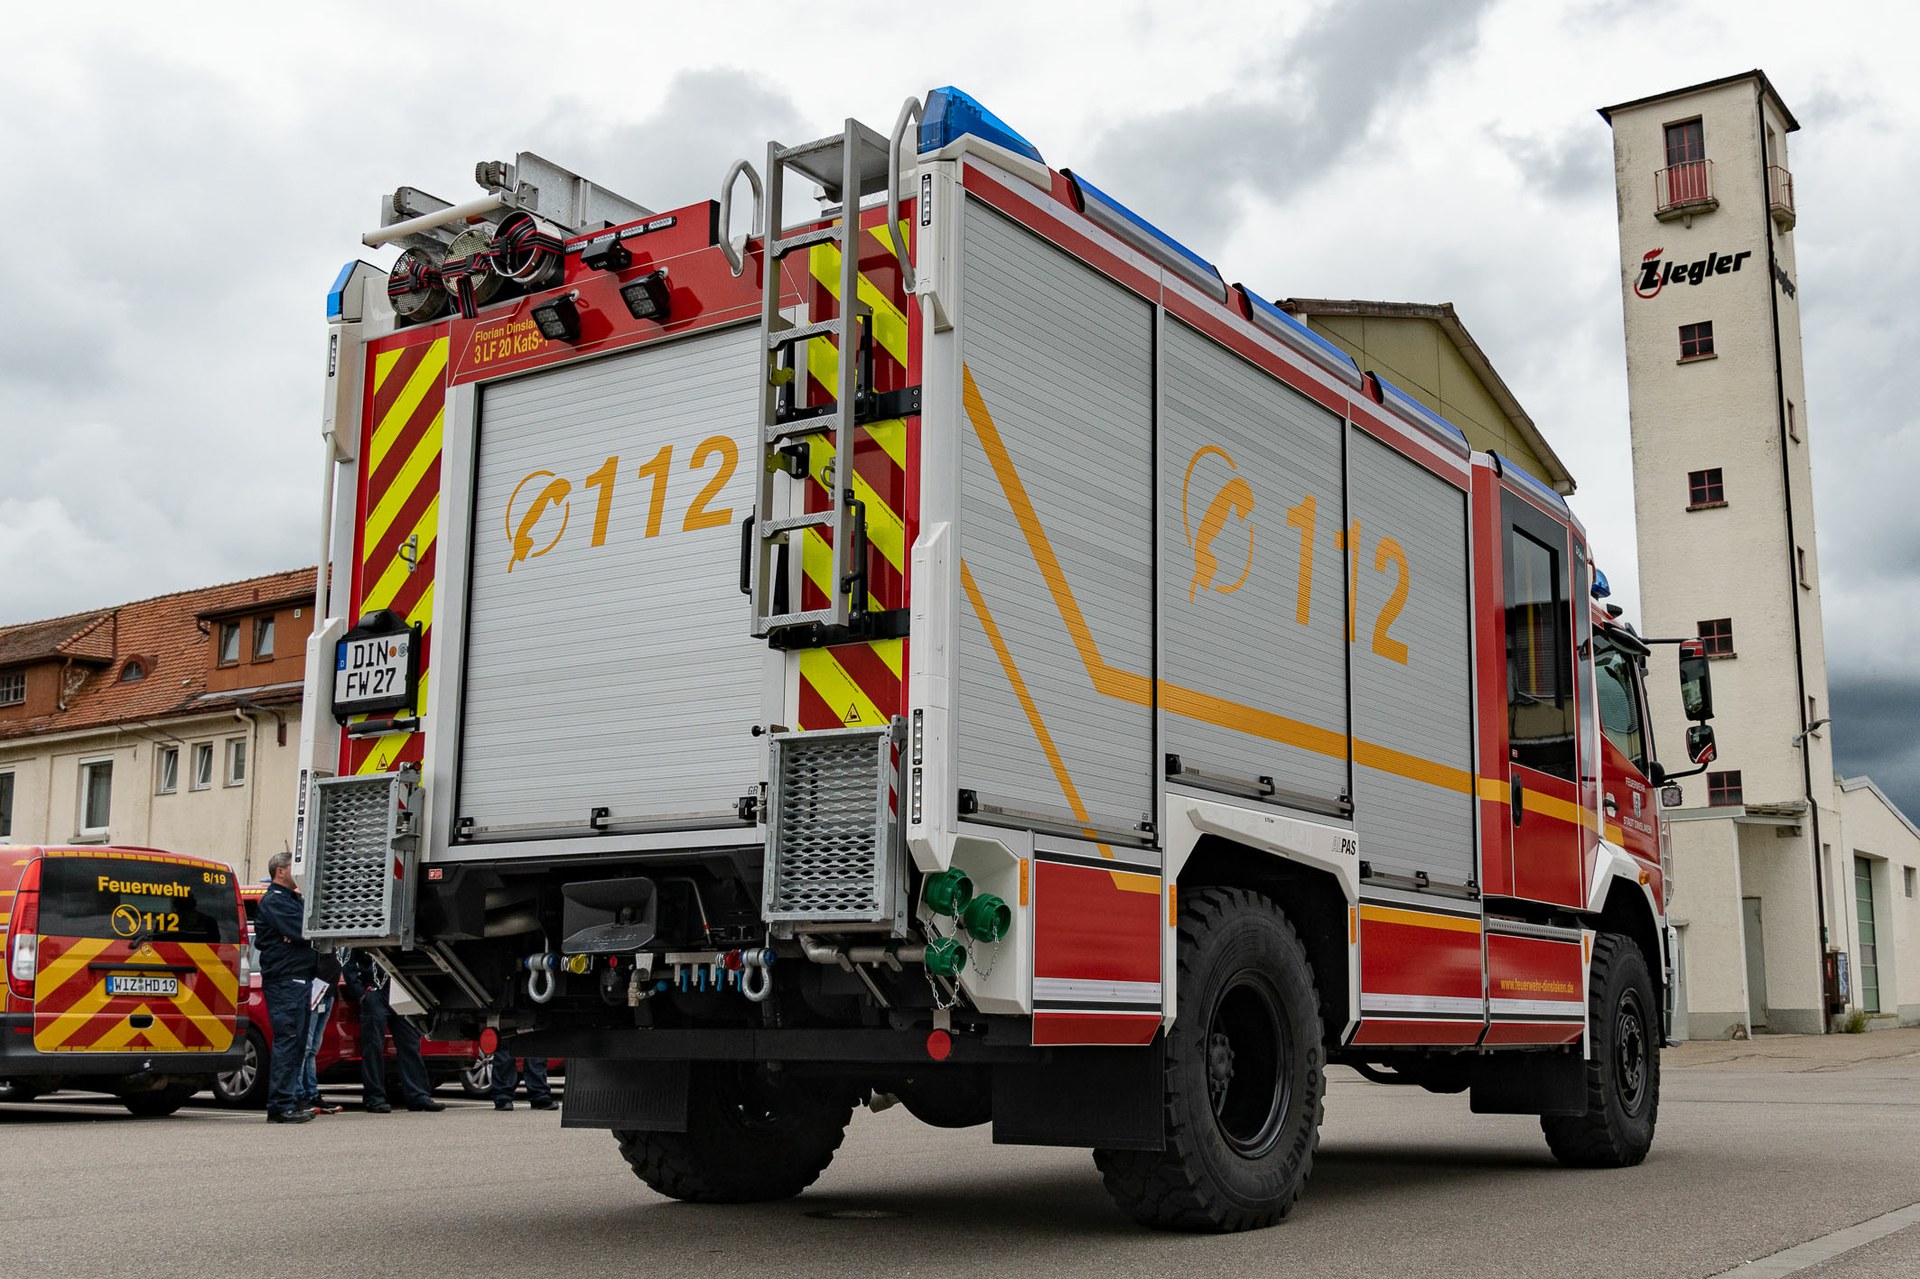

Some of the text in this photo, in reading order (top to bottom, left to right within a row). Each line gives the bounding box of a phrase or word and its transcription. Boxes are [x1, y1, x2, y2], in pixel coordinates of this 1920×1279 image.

[1639, 250, 1752, 291] Ziegler
[475, 327, 504, 343] Florian
[474, 344, 481, 364] 3
[483, 341, 497, 362] LF
[498, 337, 511, 358] 20
[585, 435, 739, 548] 112
[1286, 494, 1410, 666] 112
[353, 640, 389, 669] DIN
[346, 667, 396, 697] FW 27
[747, 785, 758, 795] GR
[97, 876, 191, 898] Feuerwehr
[203, 872, 227, 885] 8/19
[143, 913, 180, 932] 112
[114, 976, 177, 993] WIZ HD 19
